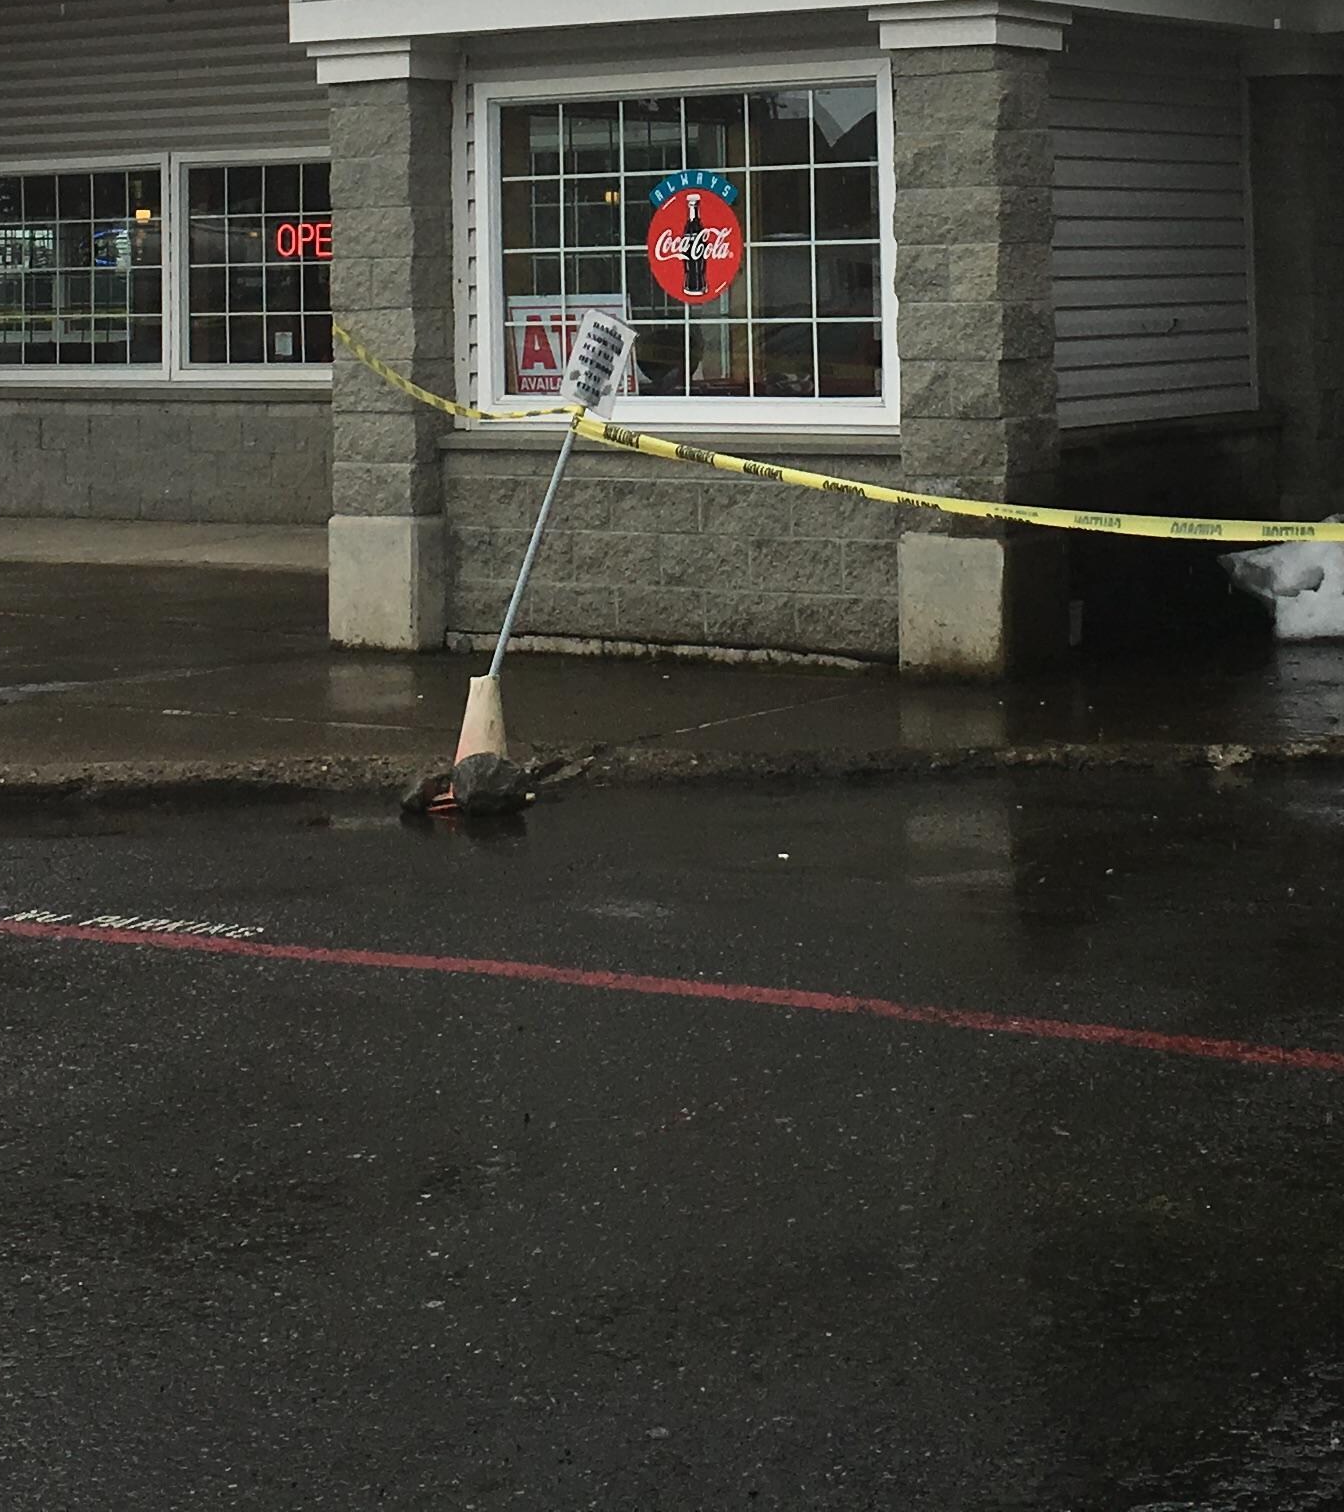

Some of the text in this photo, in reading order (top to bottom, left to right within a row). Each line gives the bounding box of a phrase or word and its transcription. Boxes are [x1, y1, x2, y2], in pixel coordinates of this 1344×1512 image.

[654, 172, 732, 201] ALWAYS
[277, 223, 332, 257] OPE
[655, 228, 732, 261] Coca-Cola
[521, 314, 577, 370] AT
[521, 377, 562, 391] AVAILA
